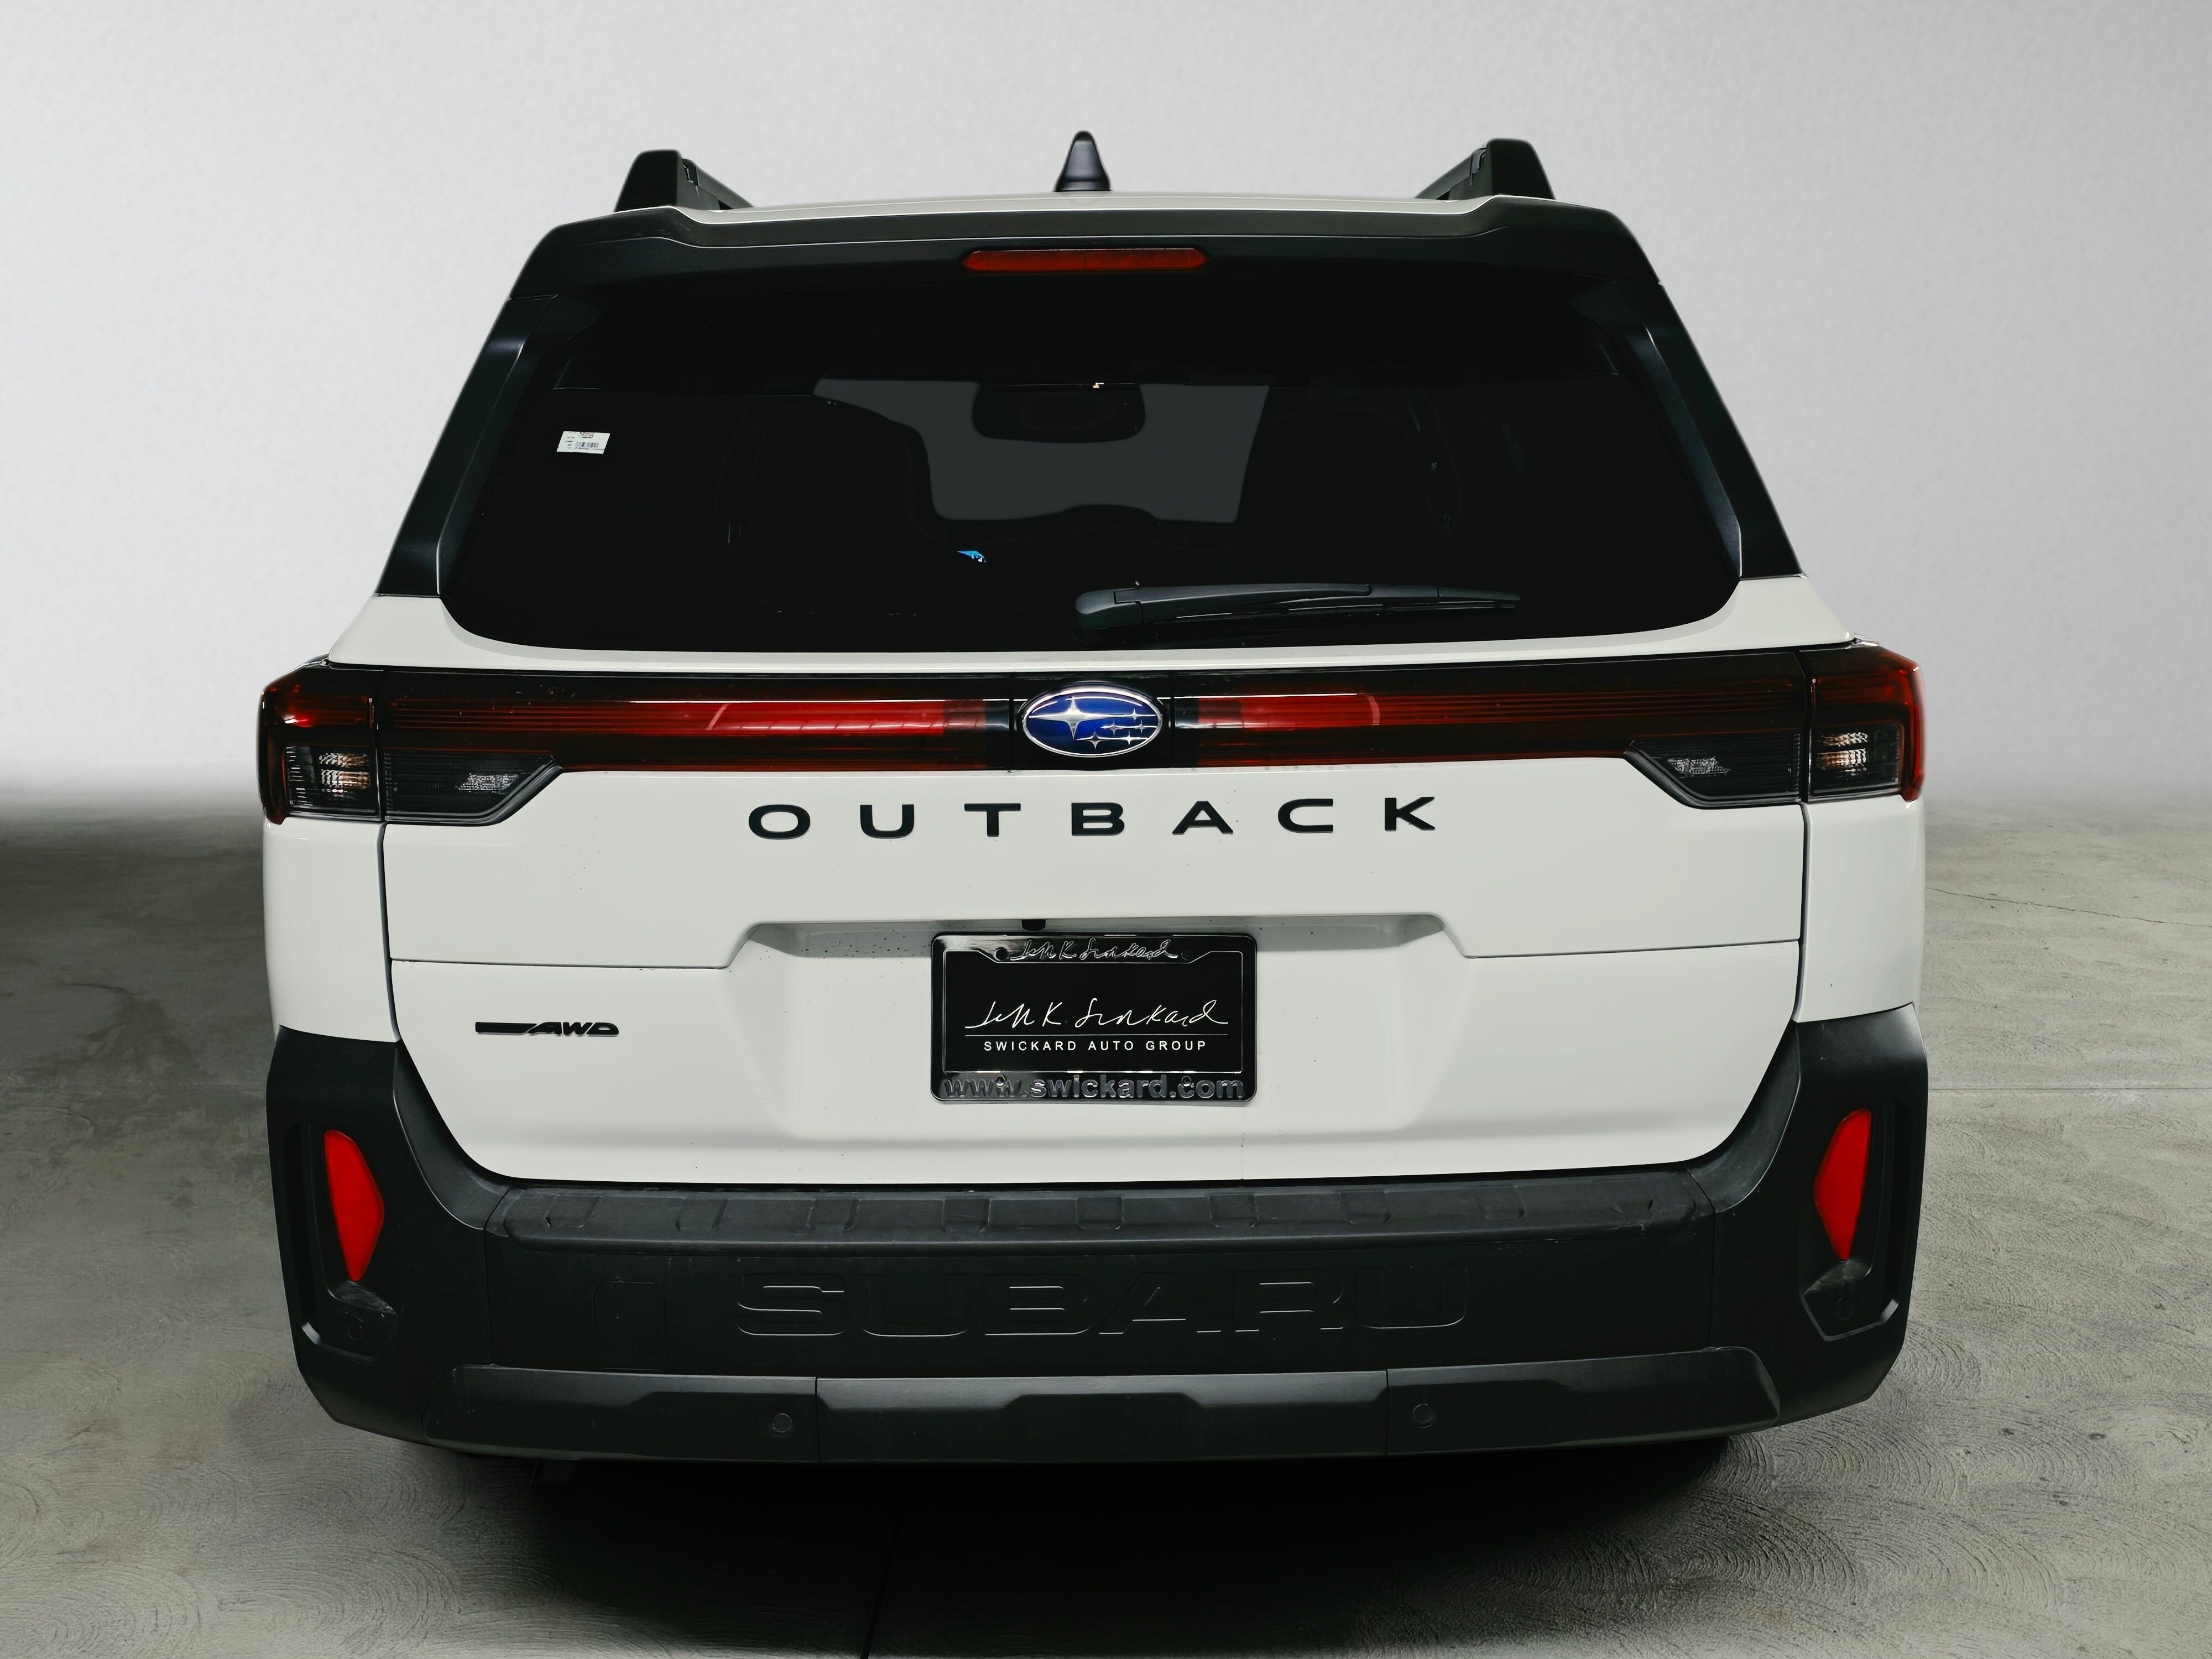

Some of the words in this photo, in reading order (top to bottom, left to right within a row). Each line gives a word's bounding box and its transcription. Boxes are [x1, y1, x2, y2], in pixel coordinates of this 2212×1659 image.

[748, 796, 1436, 839] OUTBACK
[528, 1021, 619, 1036] AWD
[983, 1040, 1077, 1051] SWICKARD
[1088, 1040, 1134, 1051] AUTO
[1145, 1040, 1207, 1051] GROUP
[943, 1074, 1244, 1099] www.swickard.com
[735, 1270, 1468, 1337] SUBARU
